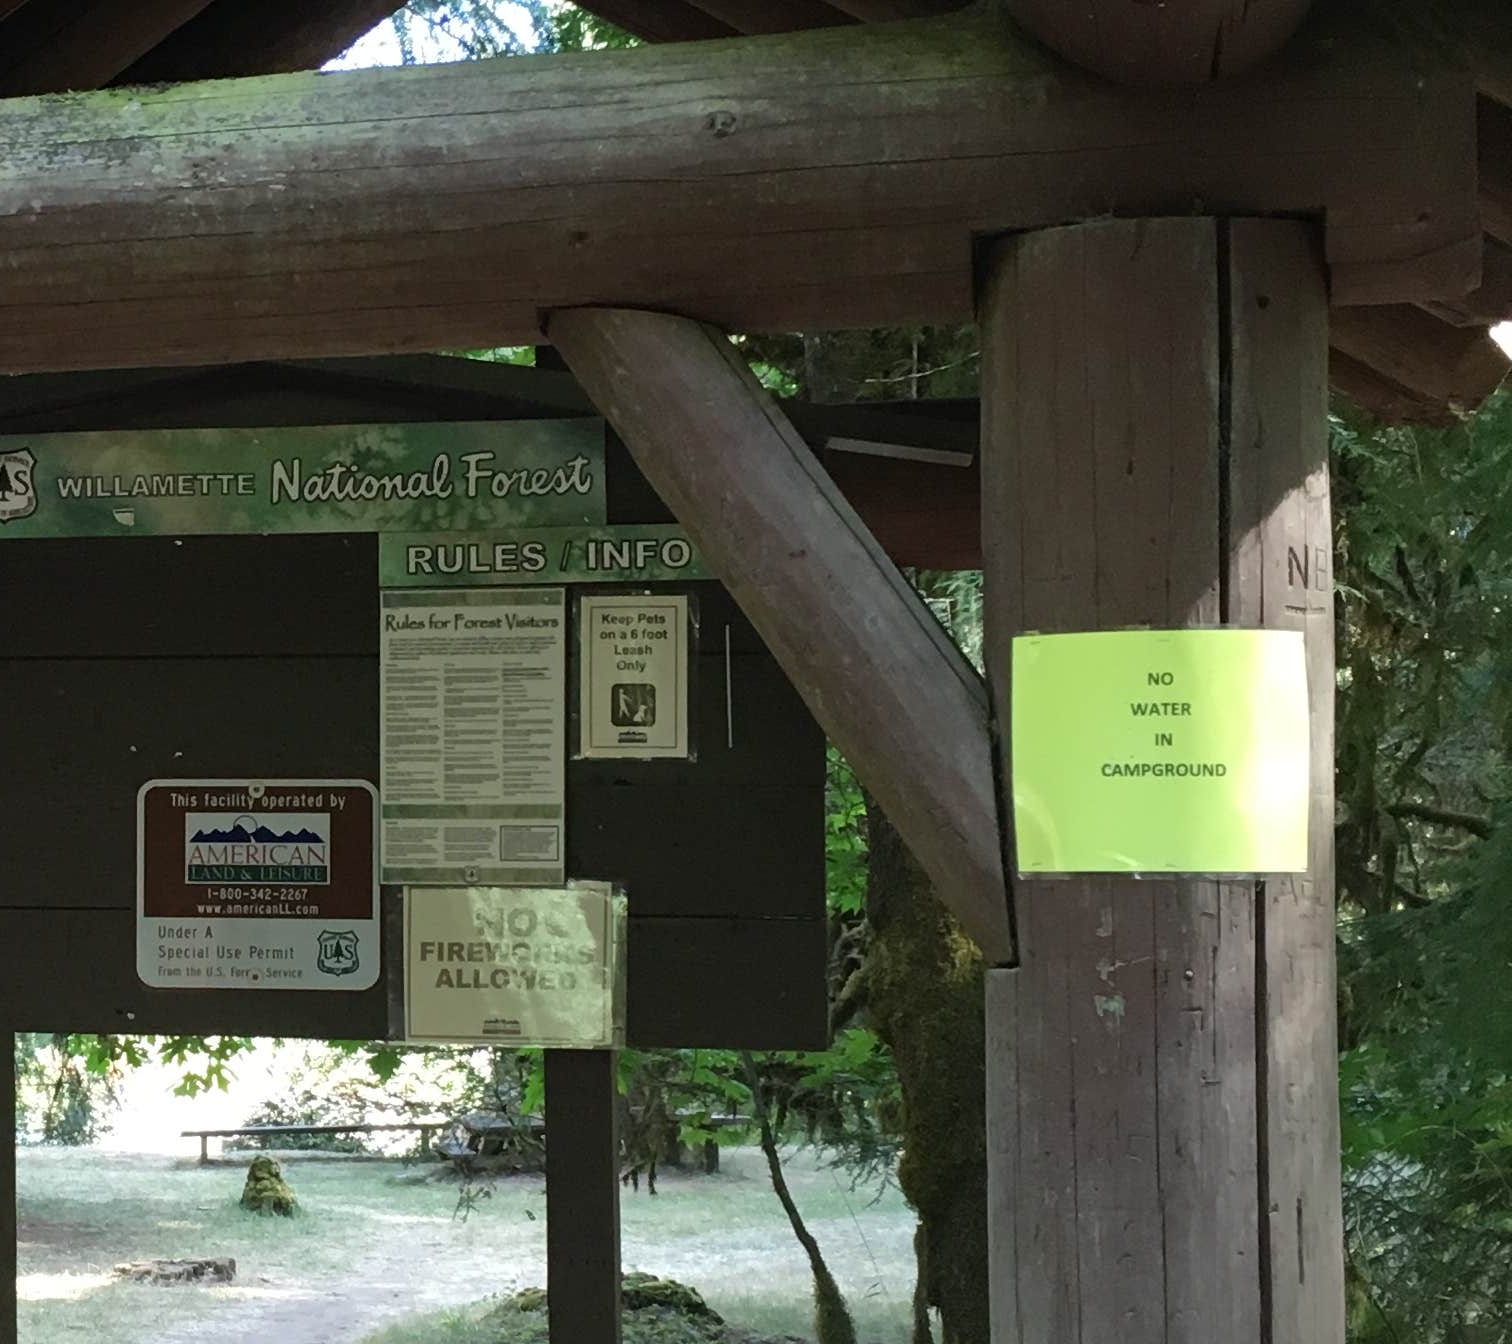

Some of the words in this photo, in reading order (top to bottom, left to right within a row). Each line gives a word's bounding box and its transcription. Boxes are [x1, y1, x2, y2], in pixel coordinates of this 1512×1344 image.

[57, 474, 256, 498] WILLAMETTE
[272, 453, 453, 503] National
[460, 452, 592, 497] Forest
[407, 542, 546, 575] RULES
[587, 538, 691, 570] INFO
[385, 613, 425, 632] Rules
[429, 613, 451, 629] for
[454, 613, 503, 631] Forest
[505, 613, 559, 630] Visitors
[601, 613, 634, 626] Keep
[638, 613, 666, 624] Pets
[600, 630, 616, 640] on
[620, 631, 627, 640] a
[630, 629, 639, 640] 6
[642, 628, 668, 640] foot
[614, 645, 653, 656] Leash
[616, 660, 647, 672] Only
[1147, 672, 1174, 687] NO
[1131, 702, 1192, 717] WATER
[1155, 733, 1173, 746] IN
[1100, 762, 1227, 778] CAMPGROUND
[170, 793, 198, 807] This
[204, 793, 254, 810] facility
[261, 793, 323, 810] operated
[330, 793, 346, 810] by
[189, 844, 326, 865] AMERICAN
[191, 866, 235, 880] LAND
[240, 867, 252, 880] &
[260, 866, 321, 881] LEISURE
[207, 888, 308, 901] 1-800-342-2267
[476, 907, 538, 938] NO
[158, 925, 197, 939] Under
[204, 926, 213, 939] A
[158, 945, 209, 962] Special
[216, 946, 242, 960] Use
[249, 946, 295, 960] Permit
[158, 965, 181, 977] From
[186, 965, 202, 977] the
[206, 965, 226, 977] U.S.
[266, 967, 303, 979] Service
[436, 968, 578, 990] ALLOWED
